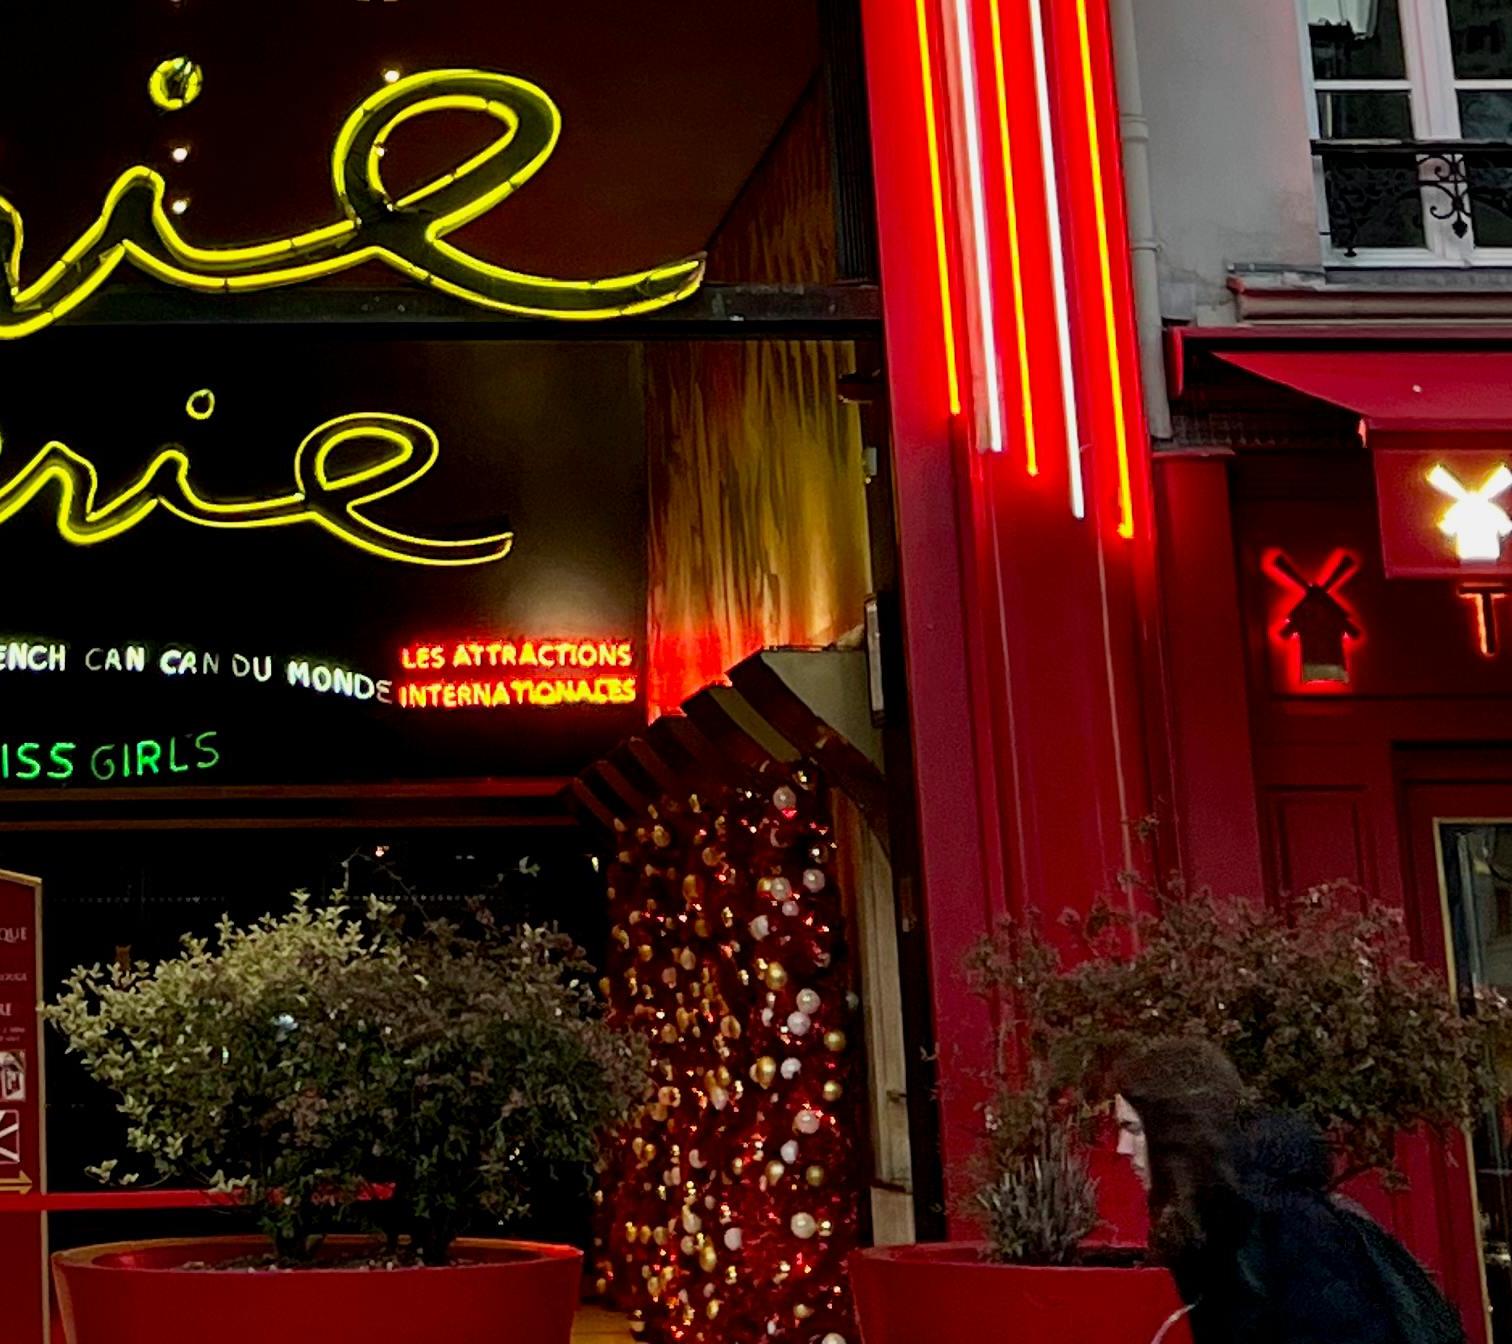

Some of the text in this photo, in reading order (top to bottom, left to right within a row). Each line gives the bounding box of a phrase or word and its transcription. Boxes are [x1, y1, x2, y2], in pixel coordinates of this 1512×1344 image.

[84, 645, 146, 672] CAN
[159, 648, 220, 676] CAN
[231, 652, 273, 683] DU
[286, 660, 393, 705] MONDE
[400, 640, 633, 669] LES ATTRACTIONS
[398, 676, 638, 708] INTERNATIONALES
[90, 731, 220, 781] GIRLS
